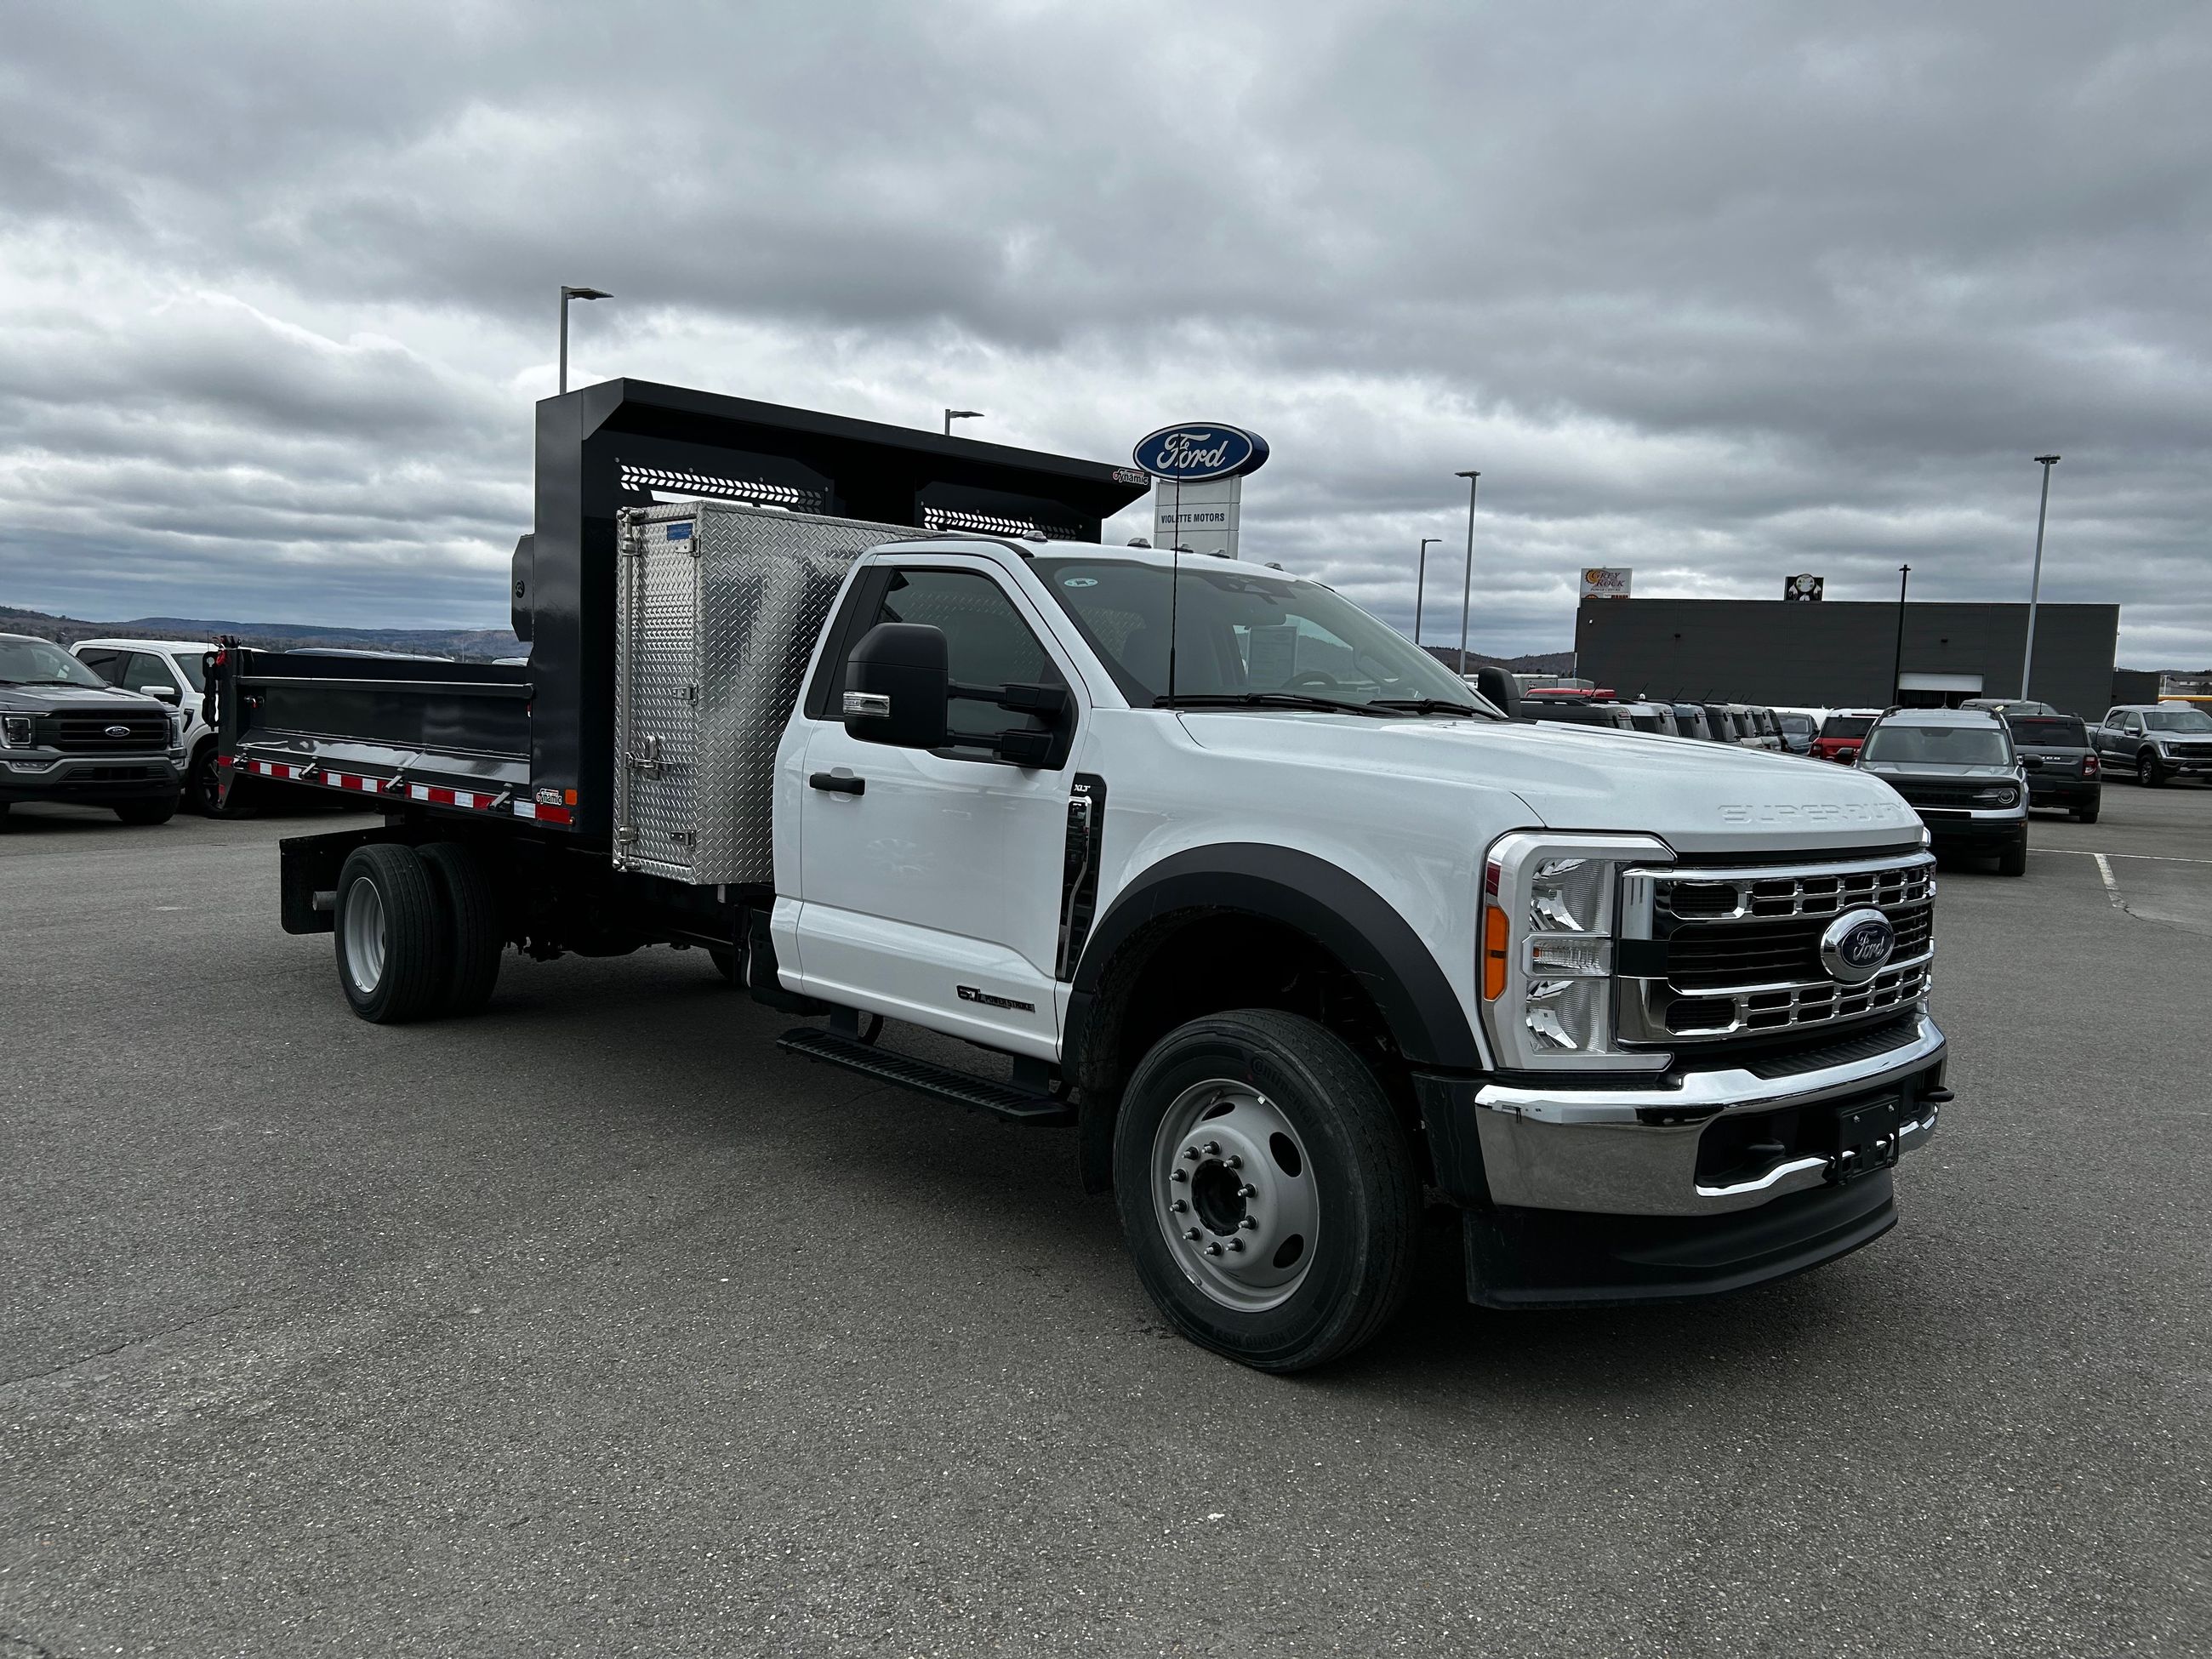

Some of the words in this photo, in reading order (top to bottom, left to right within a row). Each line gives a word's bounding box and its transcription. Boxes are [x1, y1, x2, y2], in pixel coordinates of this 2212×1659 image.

[1157, 433, 1229, 469] Ford
[1194, 513, 1225, 522] MOTORS
[1073, 784, 1092, 792] XLT
[1853, 930, 1885, 961] Ford
